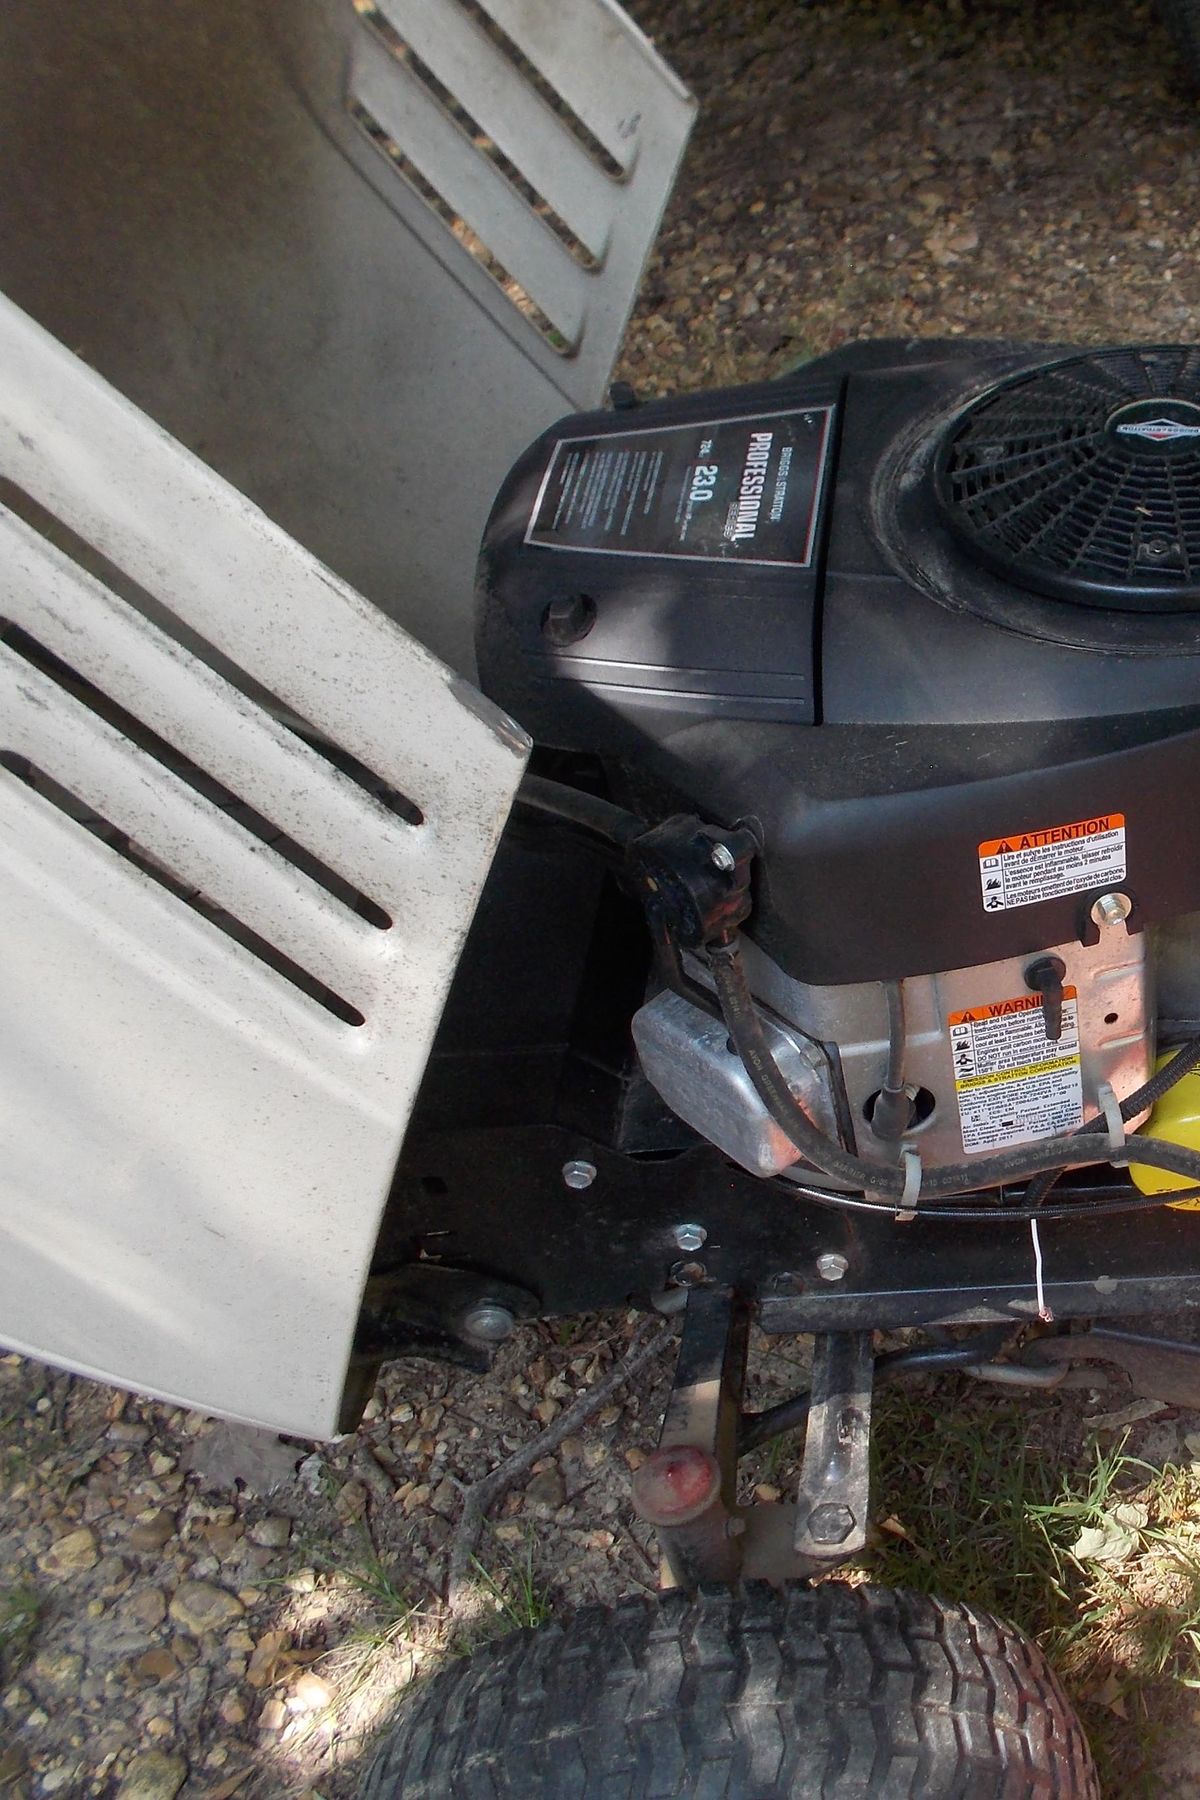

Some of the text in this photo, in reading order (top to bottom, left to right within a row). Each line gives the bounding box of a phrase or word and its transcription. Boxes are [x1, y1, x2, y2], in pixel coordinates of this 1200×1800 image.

[779, 445, 793, 476] BRIGGS
[688, 464, 719, 502] 23.0
[731, 431, 774, 542] PROFESSIONAL
[769, 481, 788, 521] STRATTON
[1019, 818, 1109, 849] ATTENTION
[1003, 830, 1118, 862] Lire et suivre les instructions d'utilisation
[1004, 859, 1020, 868] avant
[1064, 844, 1085, 855] moteur.
[1004, 844, 1123, 877] L'essence est inflammable, laisser refroidir
[1012, 872, 1032, 882] moteur
[1033, 866, 1057, 877] pendant
[1057, 864, 1065, 872] au
[1066, 860, 1083, 870] moins
[1089, 854, 1111, 865] minutes
[1005, 881, 1022, 890] avant
[1029, 871, 1066, 886] remplissage.
[1006, 892, 1016, 900] Les
[1017, 887, 1041, 897] moteurs
[1100, 867, 1125, 878] carbone,
[1007, 898, 1015, 906] NE
[1015, 895, 1028, 904] PAS
[1029, 892, 1041, 901] faire
[1041, 885, 1074, 898] fonctionner
[1073, 882, 1088, 891] dans
[1096, 876, 1109, 885] local
[1109, 873, 1123, 882] clos.
[989, 995, 1044, 1017] WARNI
[973, 1013, 1017, 1028] Read and follow
[974, 1018, 1026, 1034] Instructions before
[975, 1031, 999, 1042] Gasoline
[975, 1041, 987, 1049] cool
[994, 1036, 1007, 1044] least
[1012, 1030, 1033, 1040] minutes
[976, 1038, 1032, 1056] Engines emit carbon
[978, 1041, 1077, 1069] Muffler area temperature may exceed
[987, 1052, 1001, 1060] NOT
[1019, 1042, 1046, 1053] enclosed
[1016, 1057, 1032, 1066] touch
[960, 1079, 986, 1090] BRIGGS
[994, 1070, 1029, 1082] STRATTON
[1030, 1059, 1076, 1074] CORPORATION
[963, 1055, 1074, 1085] EMISSION CONTROL INFORMATION
[982, 1081, 1005, 1090] owner's
[1006, 1076, 1026, 1085] manual
[1037, 1065, 1073, 1078] maintenance
[1022, 1076, 1051, 1086] emissions
[1052, 1069, 1079, 1080] durability
[960, 1099, 987, 1109] California
[1019, 1084, 1051, 1095] regulations
[986, 1090, 1006, 1099] engine
[1007, 1086, 1025, 1094] meets
[1043, 1098, 1070, 1108] Extended
[960, 1105, 981, 1114] Engine
[1065, 1105, 1081, 1113] Clean
[977, 1126, 1004, 1137] Emission
[1026, 1123, 1039, 1131] EPA
